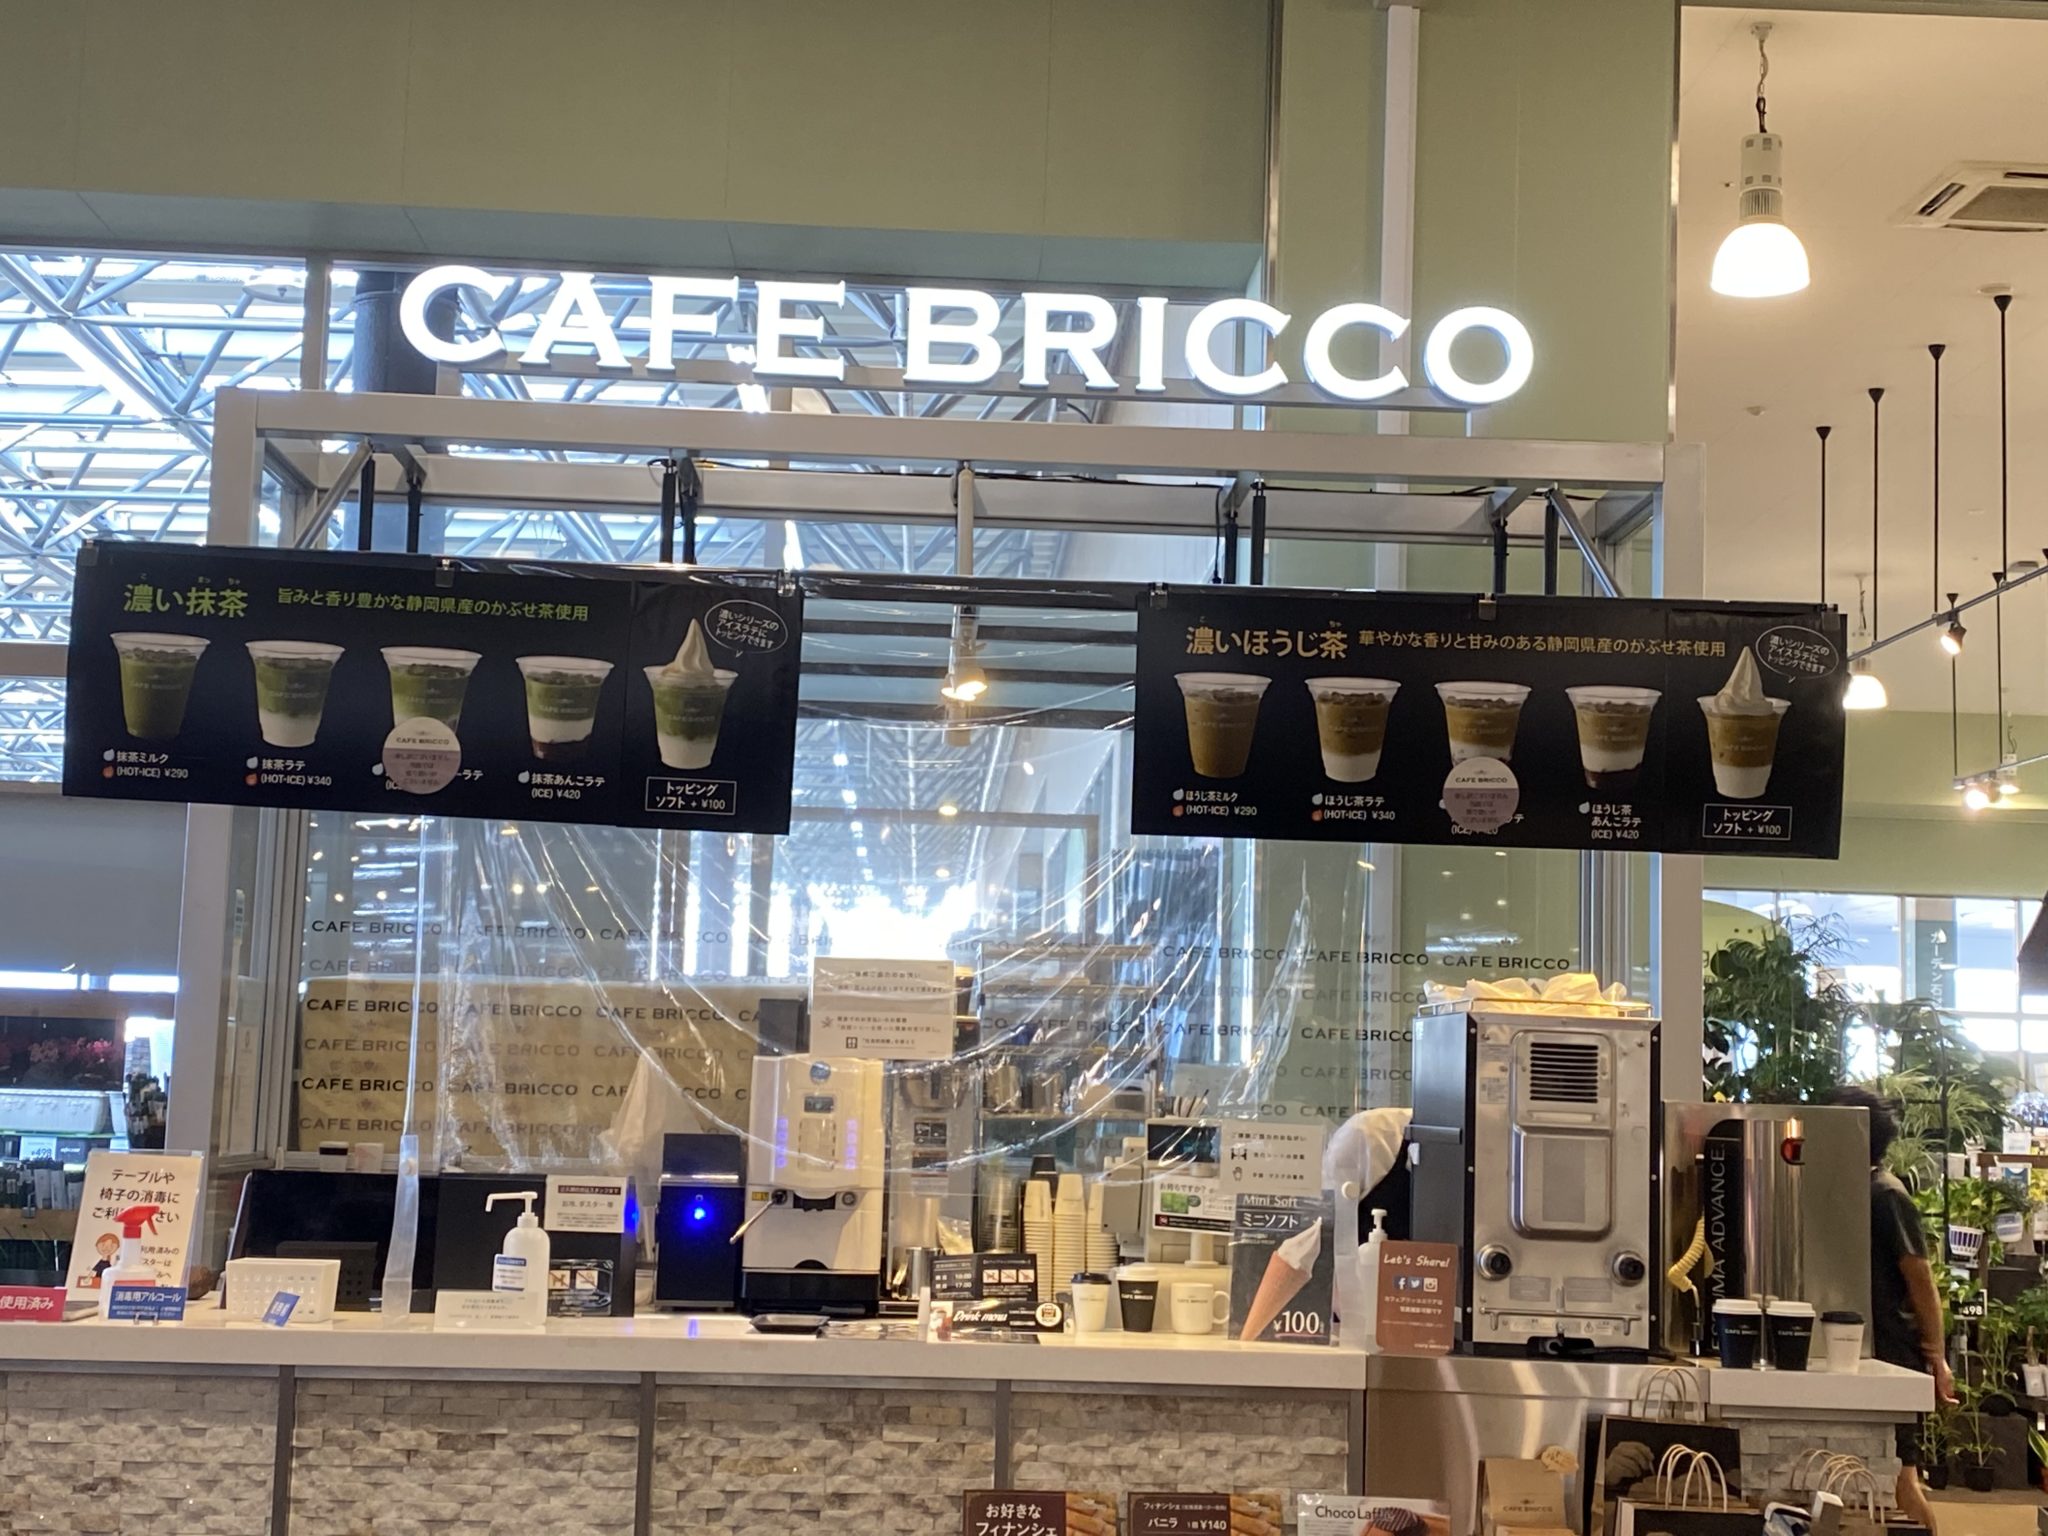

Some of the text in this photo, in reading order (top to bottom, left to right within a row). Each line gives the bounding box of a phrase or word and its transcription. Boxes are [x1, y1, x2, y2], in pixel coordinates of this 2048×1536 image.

[400, 264, 1535, 404] CAFE BRICCO
[124, 584, 249, 618] 濃い抹茶
[277, 587, 590, 622] 旨みと香り豊かな静岡県産のかぶせ茶使用
[1185, 626, 1348, 660] 濃いほうじ茶
[116, 751, 169, 764] 抹茶ミルク
[262, 759, 306, 771] 抹茶ラテ
[164, 768, 189, 779] ¥290
[531, 772, 606, 787] 抹茶あんこラテ
[307, 776, 332, 787] ¥340
[666, 781, 719, 796] トッピング
[531, 787, 581, 800] (ICE) ¥420
[1185, 789, 1239, 803] ほうじ茶ミルク
[655, 795, 686, 809] ソフト
[701, 798, 726, 810] ¥100
[1325, 795, 1385, 807] ほうじ茶ラテ
[1233, 806, 1257, 816] ¥290
[1371, 810, 1396, 821] ¥340
[1591, 804, 1633, 816] ほうじ茶
[1722, 808, 1775, 823] トッピング
[1591, 816, 1642, 828] あんこラテ
[1712, 822, 1743, 836] ソフト
[1757, 824, 1782, 836] ¥100
[1591, 828, 1640, 840] (ICE) ¥420
[311, 919, 364, 934] CAFE
[1162, 945, 1213, 958] CAFE
[1356, 951, 1430, 966] BRICCO
[1442, 955, 1570, 971] CAFE BRICCO
[306, 998, 360, 1013] CAFE
[509, 1004, 583, 1018] BRICCO
[596, 1006, 726, 1021] CAFE BRICCO
[1301, 1027, 1350, 1040] CAFE
[304, 1038, 359, 1051] CAFE
[1300, 1066, 1350, 1080] CAFE
[301, 1077, 354, 1091] CAFE
[504, 1082, 578, 1096] BRICCO
[1300, 1105, 1350, 1118] CAFE
[300, 1117, 351, 1131] CAFE
[111, 1168, 176, 1184] テーブルや
[99, 1187, 181, 1204] 椅子の消毒に
[1242, 1194, 1298, 1207] Mini Soft
[1242, 1211, 1299, 1229] ミニソフト
[1383, 1253, 1451, 1268] Let's Share!
[114, 1291, 182, 1303] 消毒用アルコール
[1273, 1311, 1319, 1334] ¥100
[985, 1503, 1043, 1519] お好きな
[1314, 1505, 1356, 1520] Choco
[975, 1521, 1058, 1536] フィナンシェ
[1147, 1517, 1179, 1529] バニラ
[1199, 1519, 1227, 1533] ¥140
